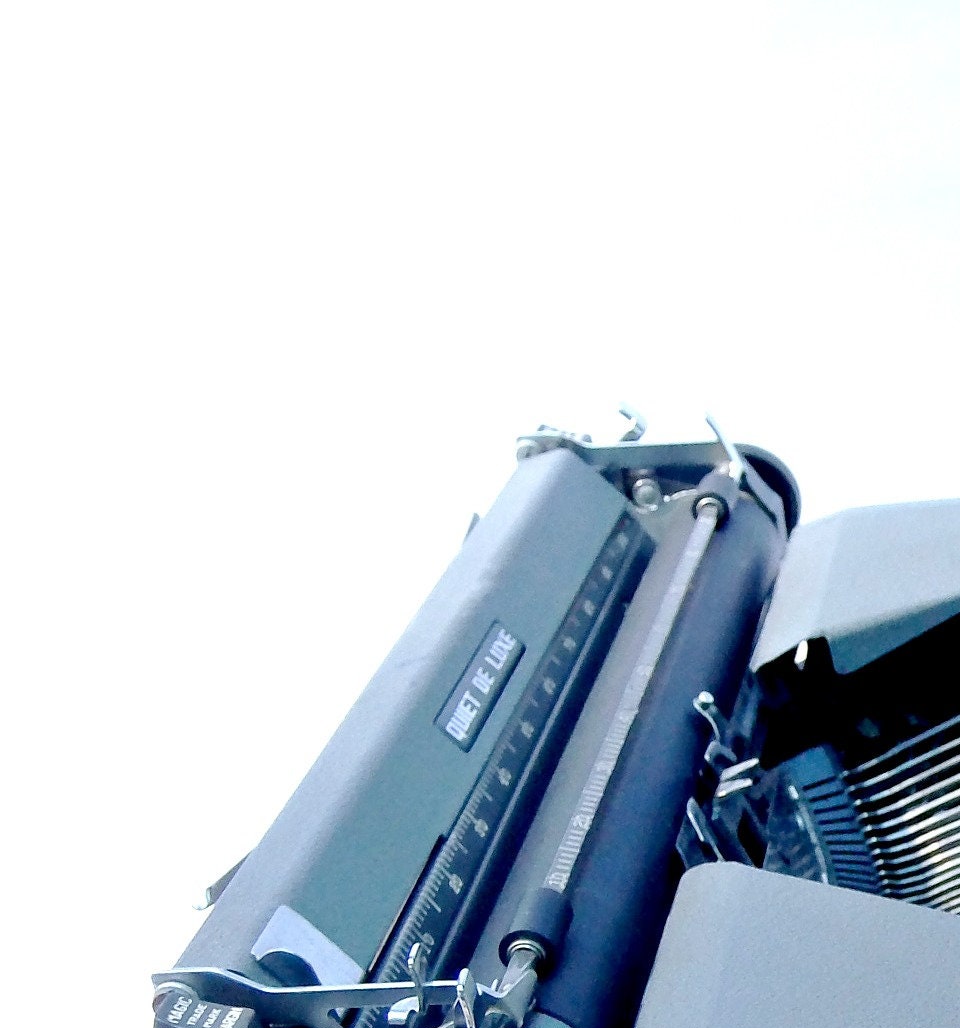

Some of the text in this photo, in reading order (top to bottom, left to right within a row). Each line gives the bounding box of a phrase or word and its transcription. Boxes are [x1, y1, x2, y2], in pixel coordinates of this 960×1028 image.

[445, 628, 516, 740] QUIET DE LUXE
[167, 996, 192, 1024] MAGIC
[187, 1004, 206, 1025] TRADE
[203, 1008, 221, 1028] MARK
